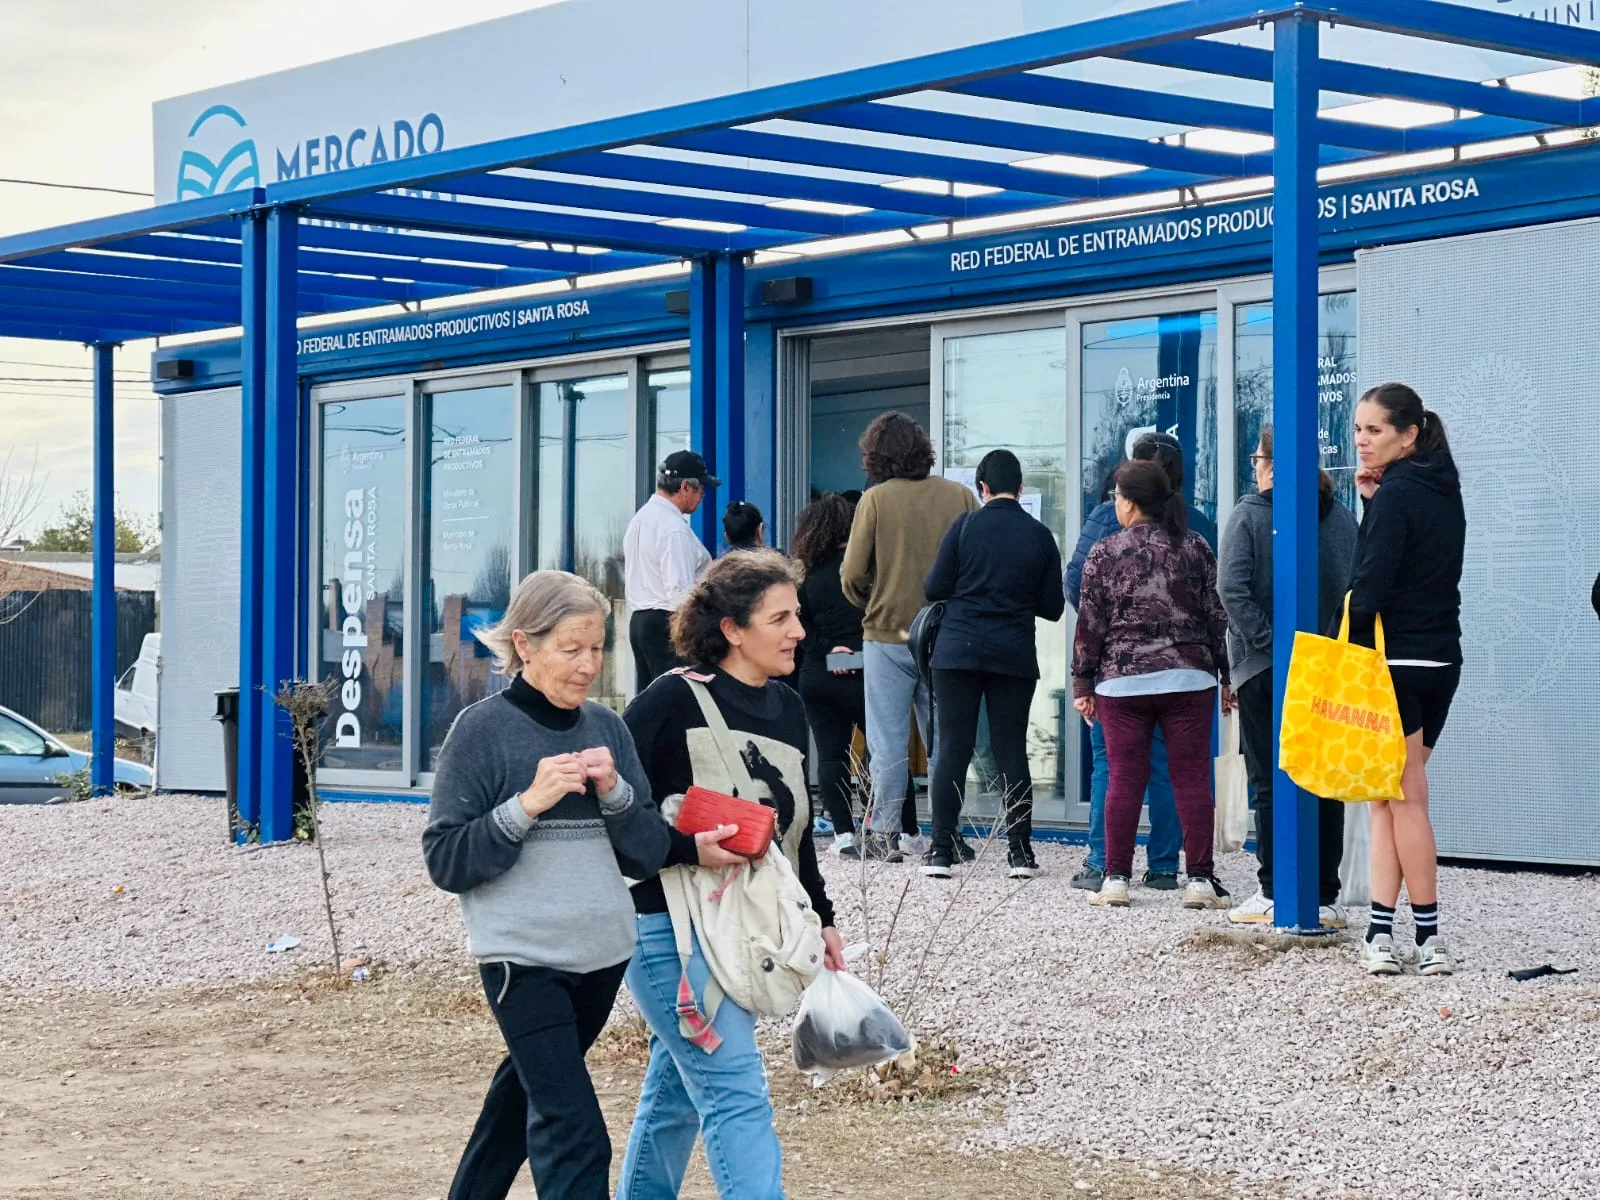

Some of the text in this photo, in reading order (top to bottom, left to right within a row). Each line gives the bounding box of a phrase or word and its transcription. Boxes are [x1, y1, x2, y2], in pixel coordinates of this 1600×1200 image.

[276, 112, 445, 182] MERCADO
[951, 250, 980, 272] RED
[984, 240, 1054, 267] FEDERAL
[1058, 235, 1079, 257] DE
[1083, 215, 1202, 254] ENTRAMADOS
[1350, 186, 1416, 214] SANTA
[1421, 177, 1480, 203] ROSA
[303, 334, 346, 354] FEDERAL
[347, 332, 361, 349] DE
[362, 323, 433, 347] ENTRAMADOS
[434, 311, 510, 338] PRODUCTIVOS
[517, 305, 554, 325] SANTA
[557, 300, 590, 318] ROSA
[1136, 390, 1171, 402] Presidencia
[1137, 373, 1190, 392] Argentina
[366, 486, 377, 601] SANTA ROSA
[335, 488, 368, 748] Despensa
[1311, 696, 1391, 734] HAVANNA
